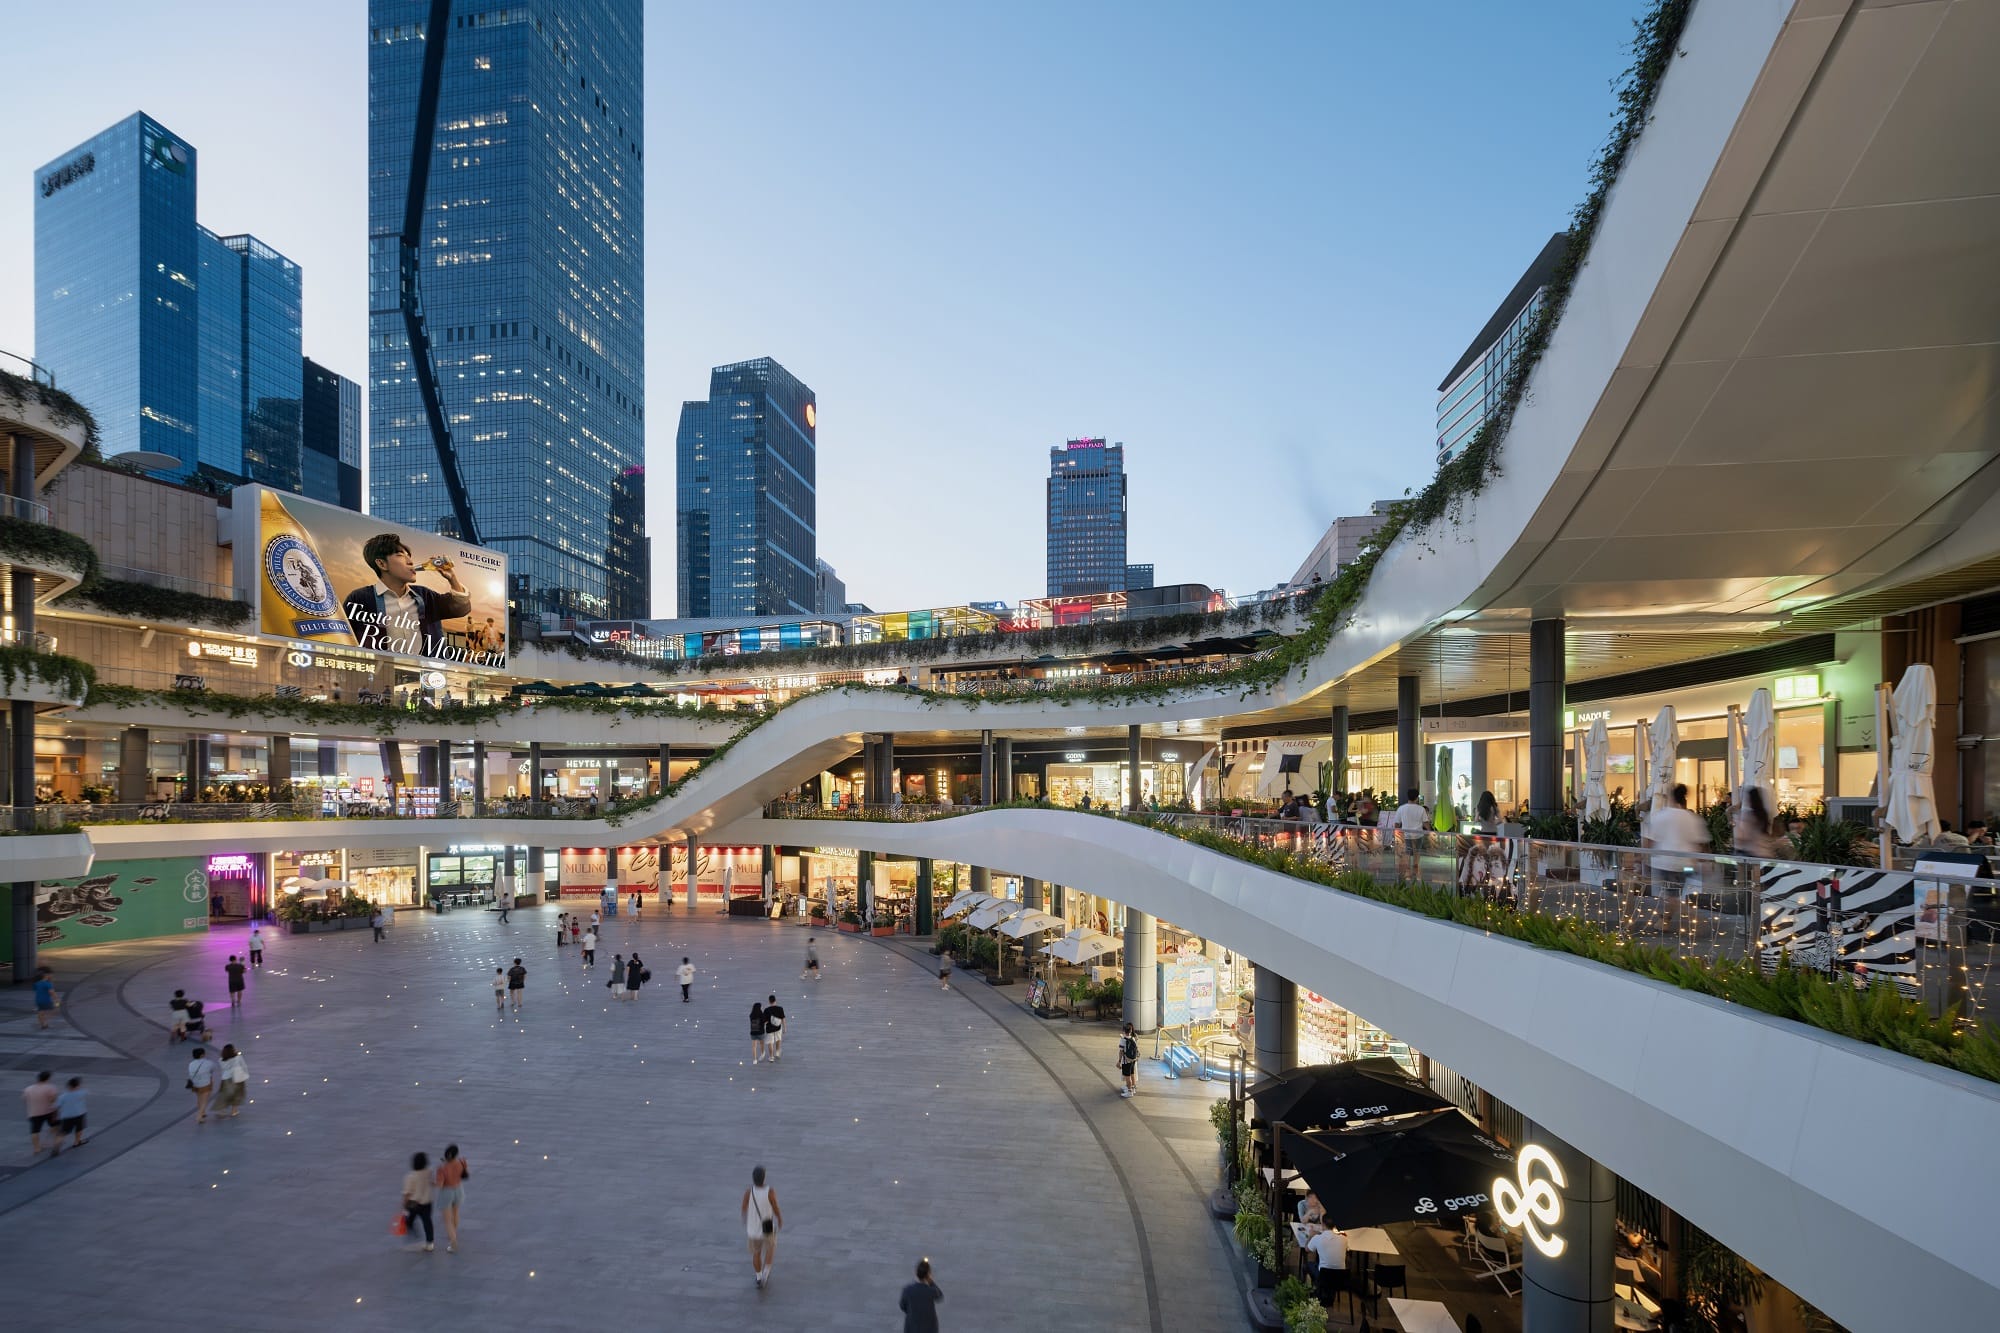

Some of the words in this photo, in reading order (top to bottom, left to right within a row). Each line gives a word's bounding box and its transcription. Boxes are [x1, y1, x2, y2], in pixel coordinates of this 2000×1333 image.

[460, 550, 481, 562] BLUE
[481, 556, 502, 567] GIRL
[282, 581, 317, 611] PILSENER
[346, 601, 392, 626] Taste
[394, 611, 421, 631] the
[300, 622, 328, 632] BLUE
[359, 623, 418, 655] Real
[419, 633, 506, 668] Moment
[1429, 721, 1440, 729] L1
[566, 760, 601, 768] HEYTEA
[565, 863, 606, 873] MULINO
[736, 864, 762, 873] MULI
[1353, 1104, 1389, 1117] gaga
[1444, 1193, 1489, 1211] gaga
